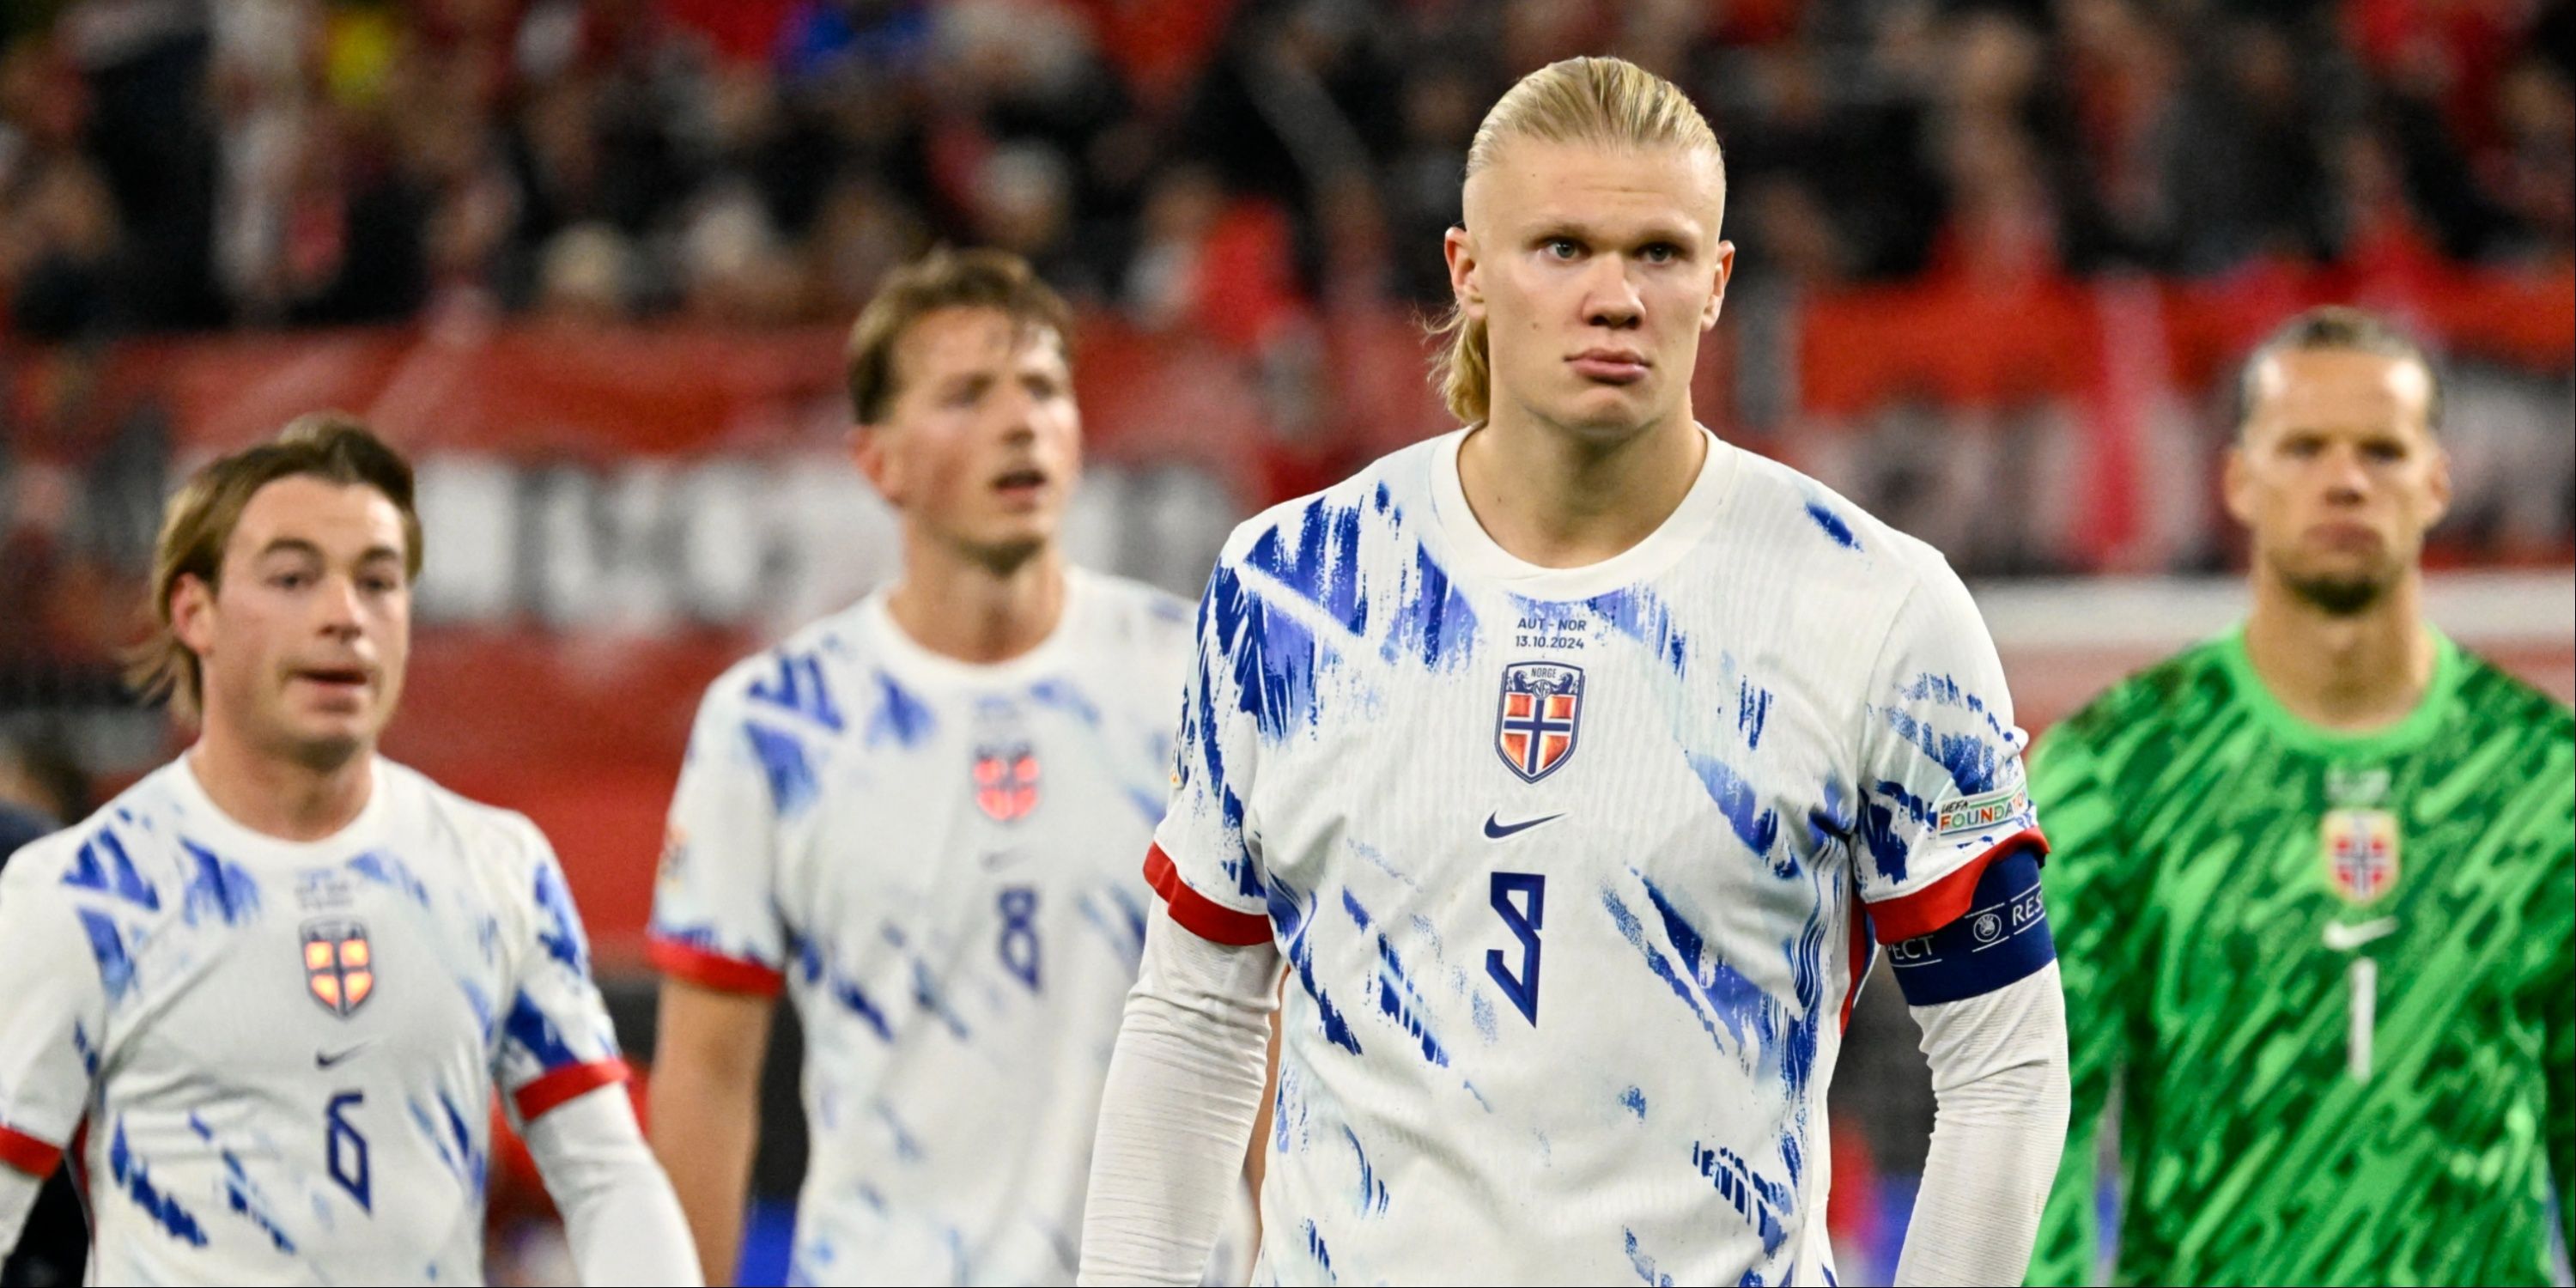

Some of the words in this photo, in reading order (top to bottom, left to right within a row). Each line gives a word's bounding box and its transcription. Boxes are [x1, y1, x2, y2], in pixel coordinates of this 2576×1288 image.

[1517, 617, 1546, 630] AUT
[1558, 619, 1588, 631] NOR
[1516, 635, 1584, 649] 13.10.2024
[1531, 667, 1558, 678] NORGE
[1941, 799, 1968, 814] UEFA
[999, 888, 1037, 992] 8
[1485, 872, 1546, 1029] 9
[1888, 935, 1934, 960] ECT
[2349, 957, 2378, 1084] 1
[325, 1090, 371, 1215] 6
